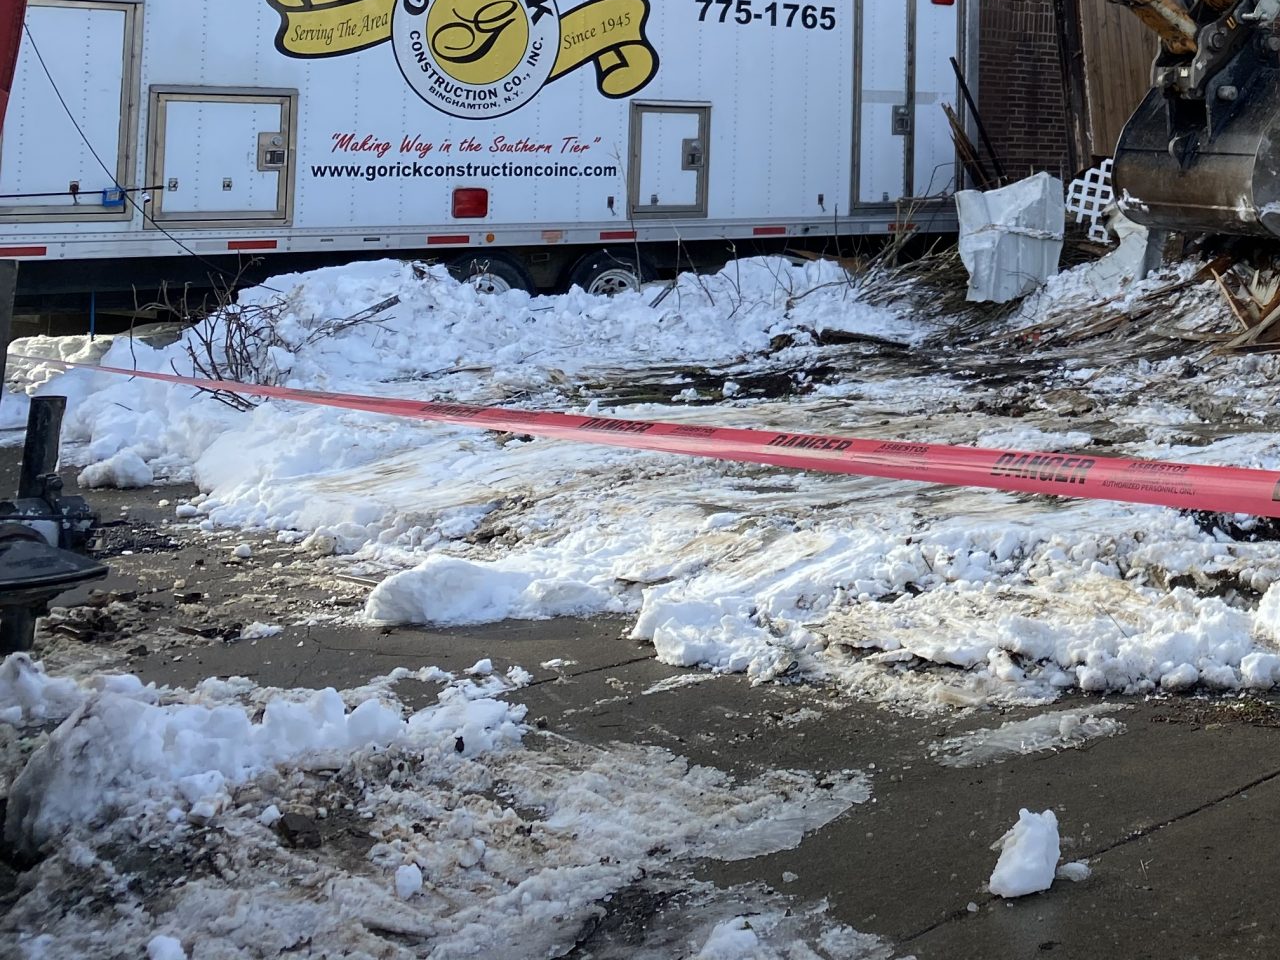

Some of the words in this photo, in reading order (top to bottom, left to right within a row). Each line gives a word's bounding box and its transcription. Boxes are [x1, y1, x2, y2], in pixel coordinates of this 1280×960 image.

[291, 24, 334, 46] Serving
[336, 18, 357, 38] The
[358, 12, 389, 37] Area
[563, 27, 597, 50] Since
[601, 12, 631, 34] 1945
[410, 30, 498, 101] CONSTRUCTION
[526, 36, 544, 67] INC.
[503, 90, 524, 104] N.Y.
[400, 134, 433, 158] Way
[439, 139, 452, 153] in
[459, 136, 482, 152] the
[489, 135, 552, 154] Southern
[311, 162, 617, 182] www.gorickconstructioncoinc.com
[990, 452, 1096, 485] DANGER
[1102, 480, 1140, 491] AUTHORIZED
[1141, 484, 1178, 494] PERSONNEL
